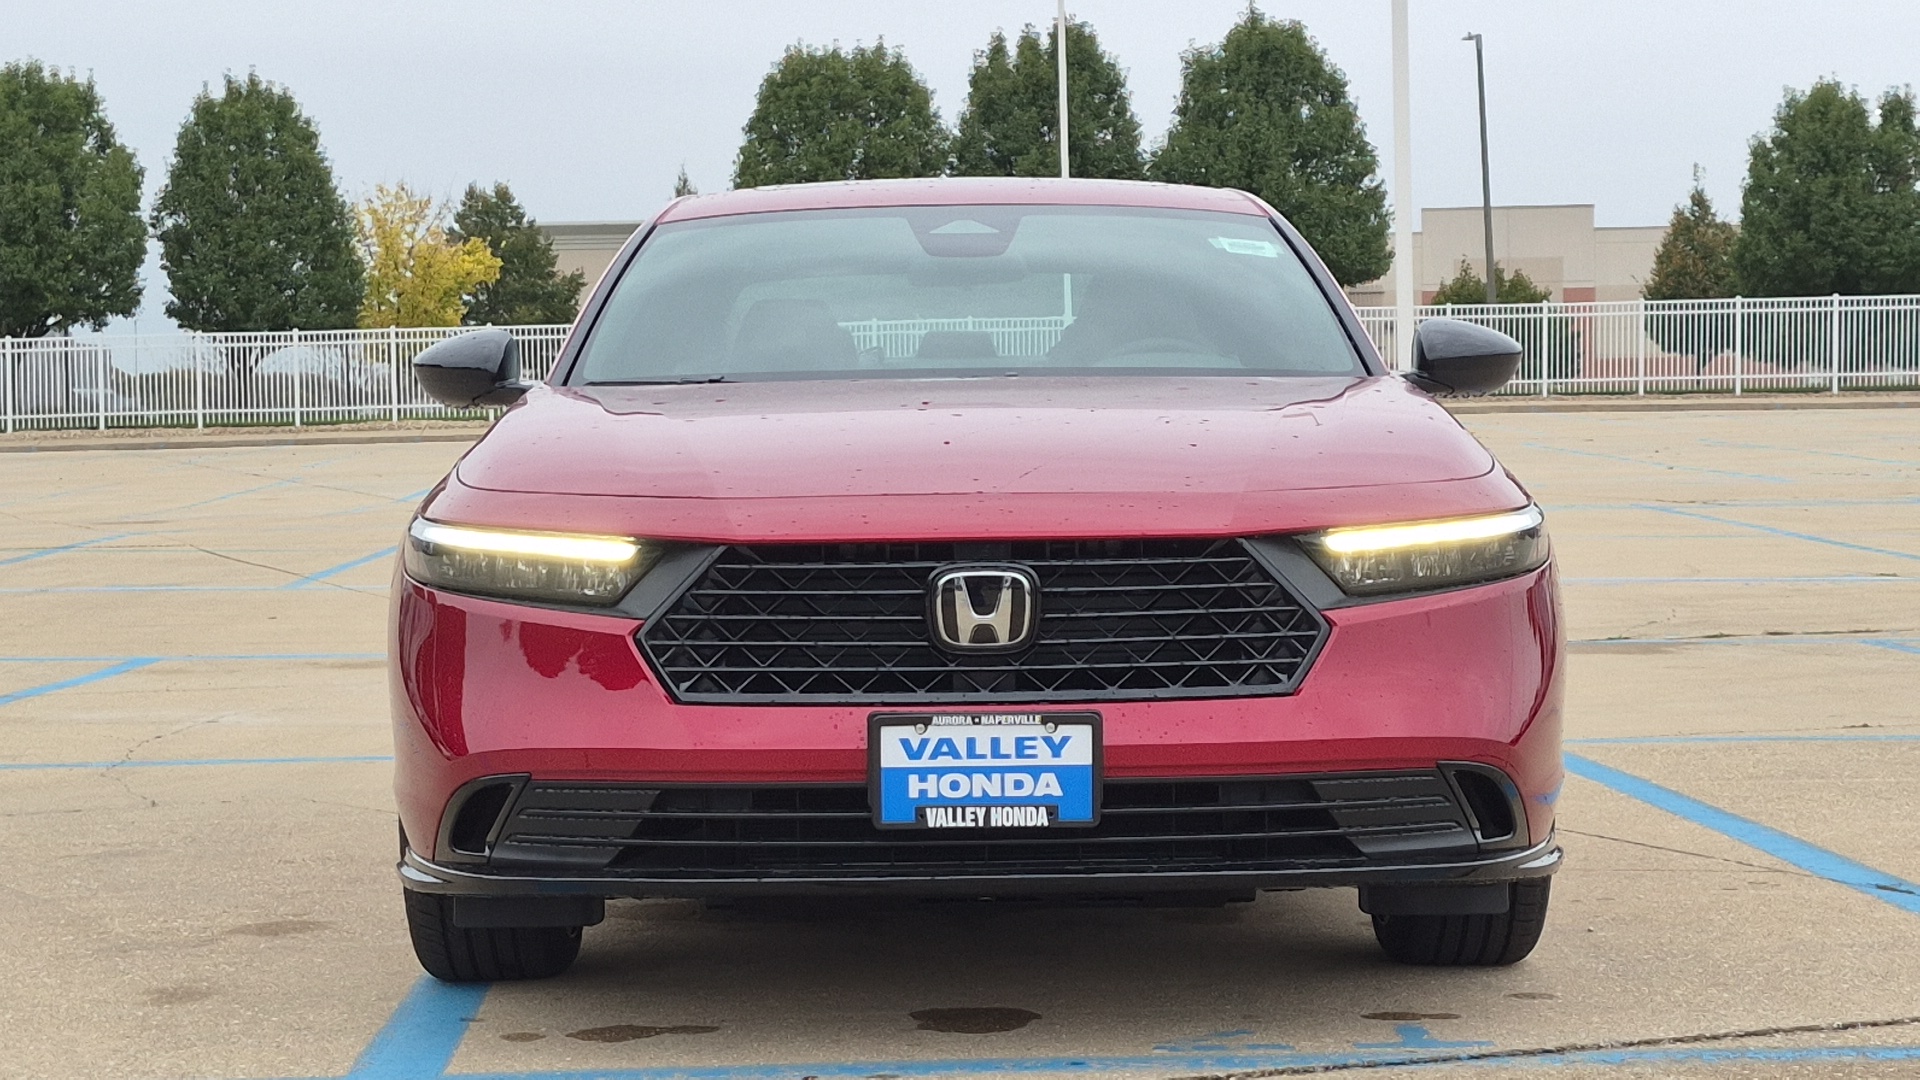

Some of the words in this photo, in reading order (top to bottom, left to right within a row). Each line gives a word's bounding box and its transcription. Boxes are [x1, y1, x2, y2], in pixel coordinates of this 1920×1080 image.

[931, 715, 973, 726] AURORA
[981, 714, 1042, 725] NAPERVILLE
[898, 735, 1073, 761] VALLEY
[908, 772, 1064, 799] HONDA
[925, 806, 986, 828] VALLEY
[990, 806, 1049, 827] HONDA
